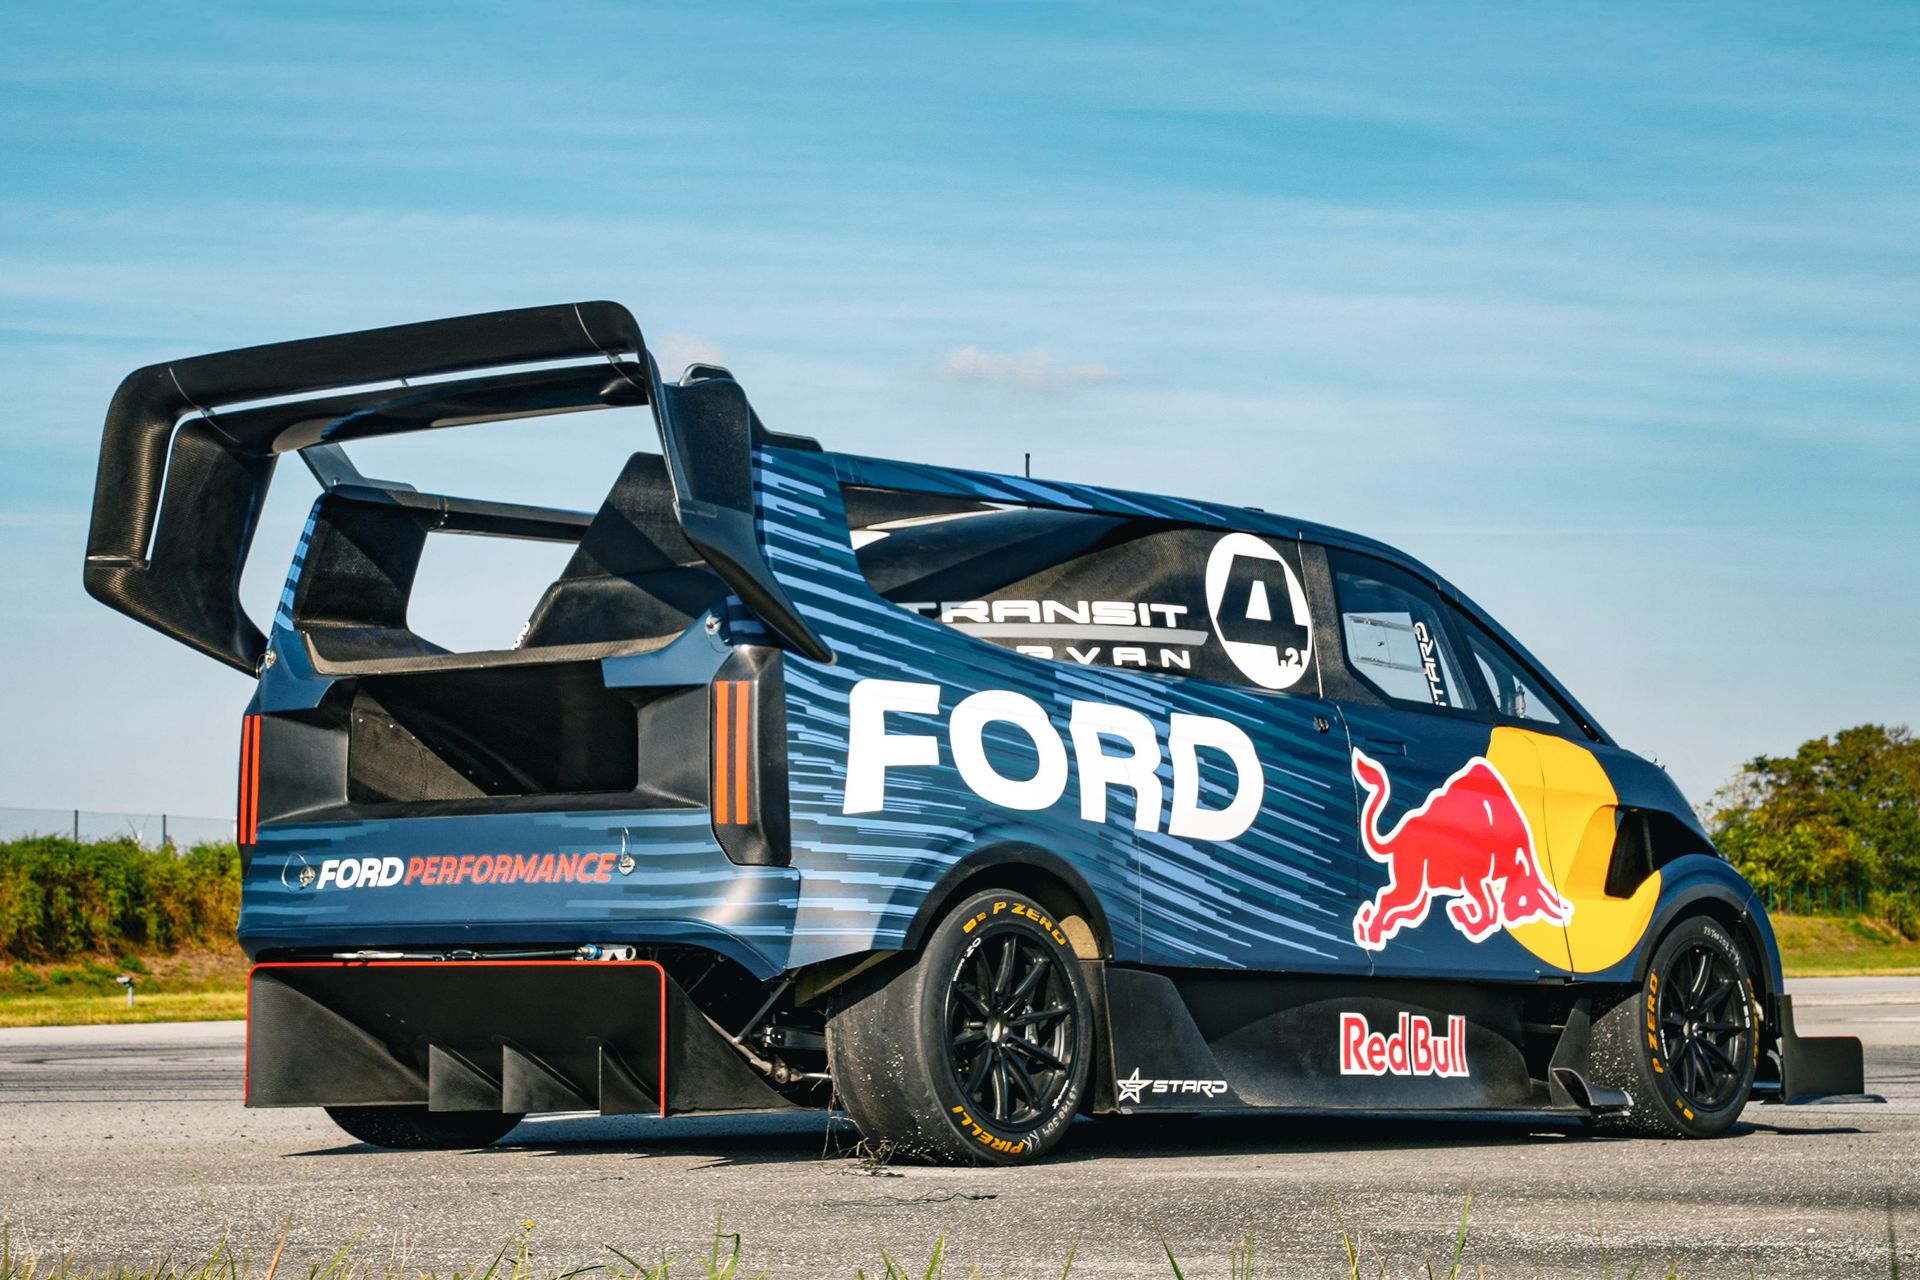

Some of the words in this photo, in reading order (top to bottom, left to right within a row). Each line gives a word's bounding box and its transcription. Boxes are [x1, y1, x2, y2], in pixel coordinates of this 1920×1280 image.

[899, 600, 1188, 628] TRANSIT
[842, 678, 1264, 841] FORD
[316, 856, 404, 890] FORD
[403, 853, 617, 886] PERFORMANCE
[993, 902, 1007, 914] P
[1010, 904, 1066, 946] ZERO
[1647, 973, 1659, 1051] ZERO
[1341, 1013, 1410, 1074] Red
[1411, 1015, 1469, 1076] Bull
[1152, 1079, 1228, 1096] STARD
[952, 1105, 1024, 1154] PIRELLI
